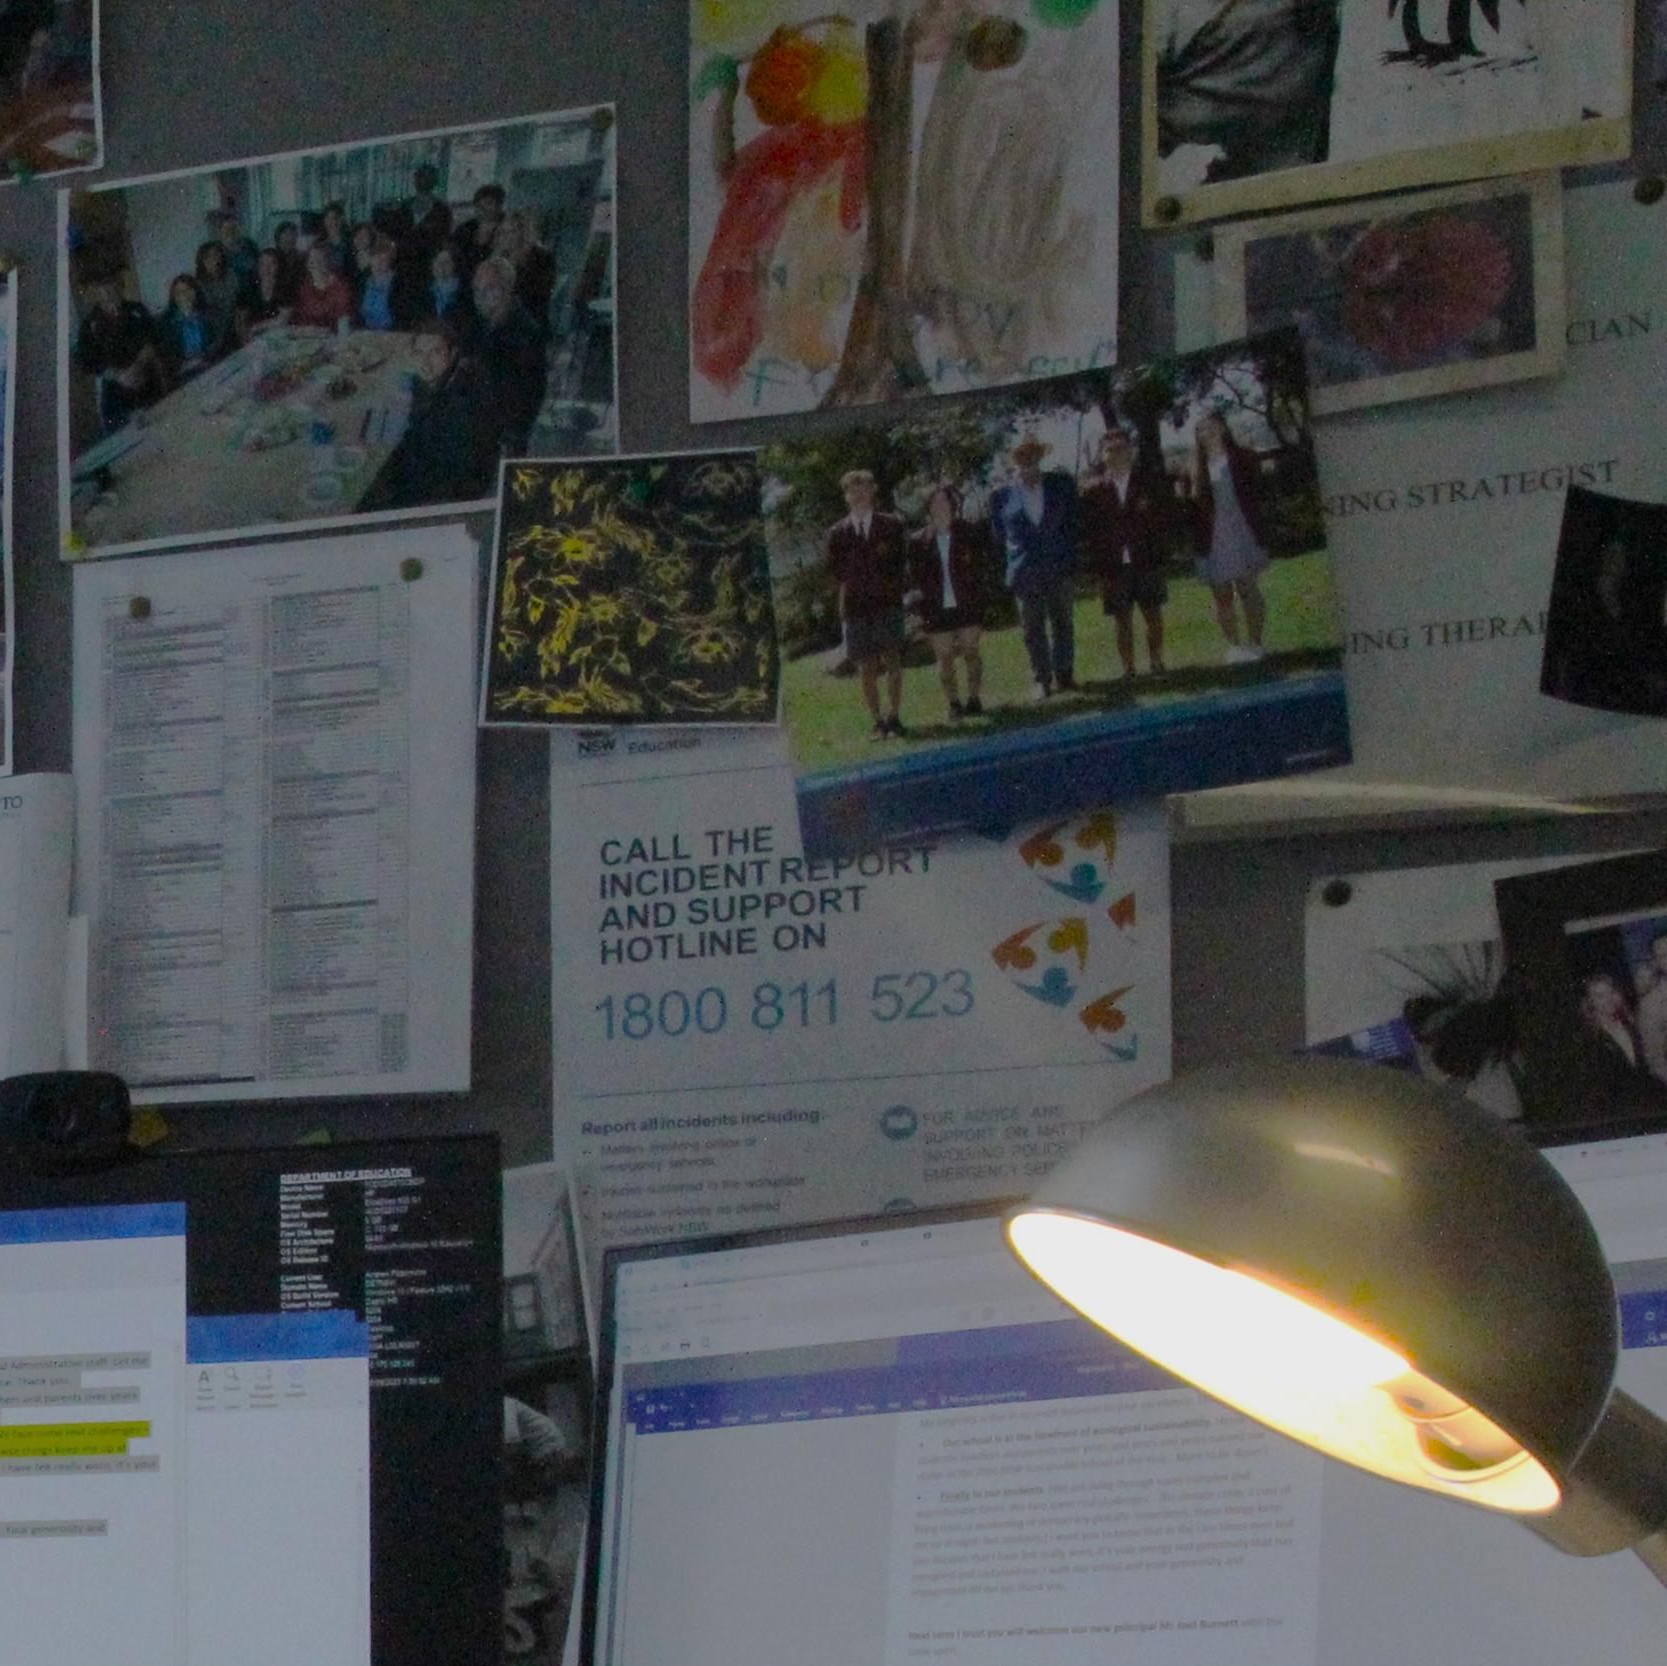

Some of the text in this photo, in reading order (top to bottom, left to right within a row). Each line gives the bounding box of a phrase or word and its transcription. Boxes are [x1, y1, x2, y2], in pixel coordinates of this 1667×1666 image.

[1406, 459, 1618, 510] STRATEGIST
[578, 737, 701, 757] NSW Education
[599, 825, 774, 866] CALL THE
[599, 844, 937, 899] INCIDENT REPORT
[599, 885, 866, 933] AND SUPPORT
[600, 920, 828, 966] HOTLINE ON
[596, 968, 975, 1041] 1800 811 523
[581, 1120, 638, 1138] Report
[639, 1117, 658, 1132] all
[659, 1114, 738, 1131] incidents
[922, 1109, 954, 1125] FOR
[964, 1105, 1021, 1121] ADVICE
[923, 1126, 997, 1145] SUPPORT
[1004, 1124, 1029, 1139] ON
[922, 1142, 1005, 1163] INVOLVING
[280, 1171, 343, 1185] DEPARTMENT
[358, 1167, 413, 1181] EDUCATION
[922, 1162, 1018, 1181] EMERGENCY
